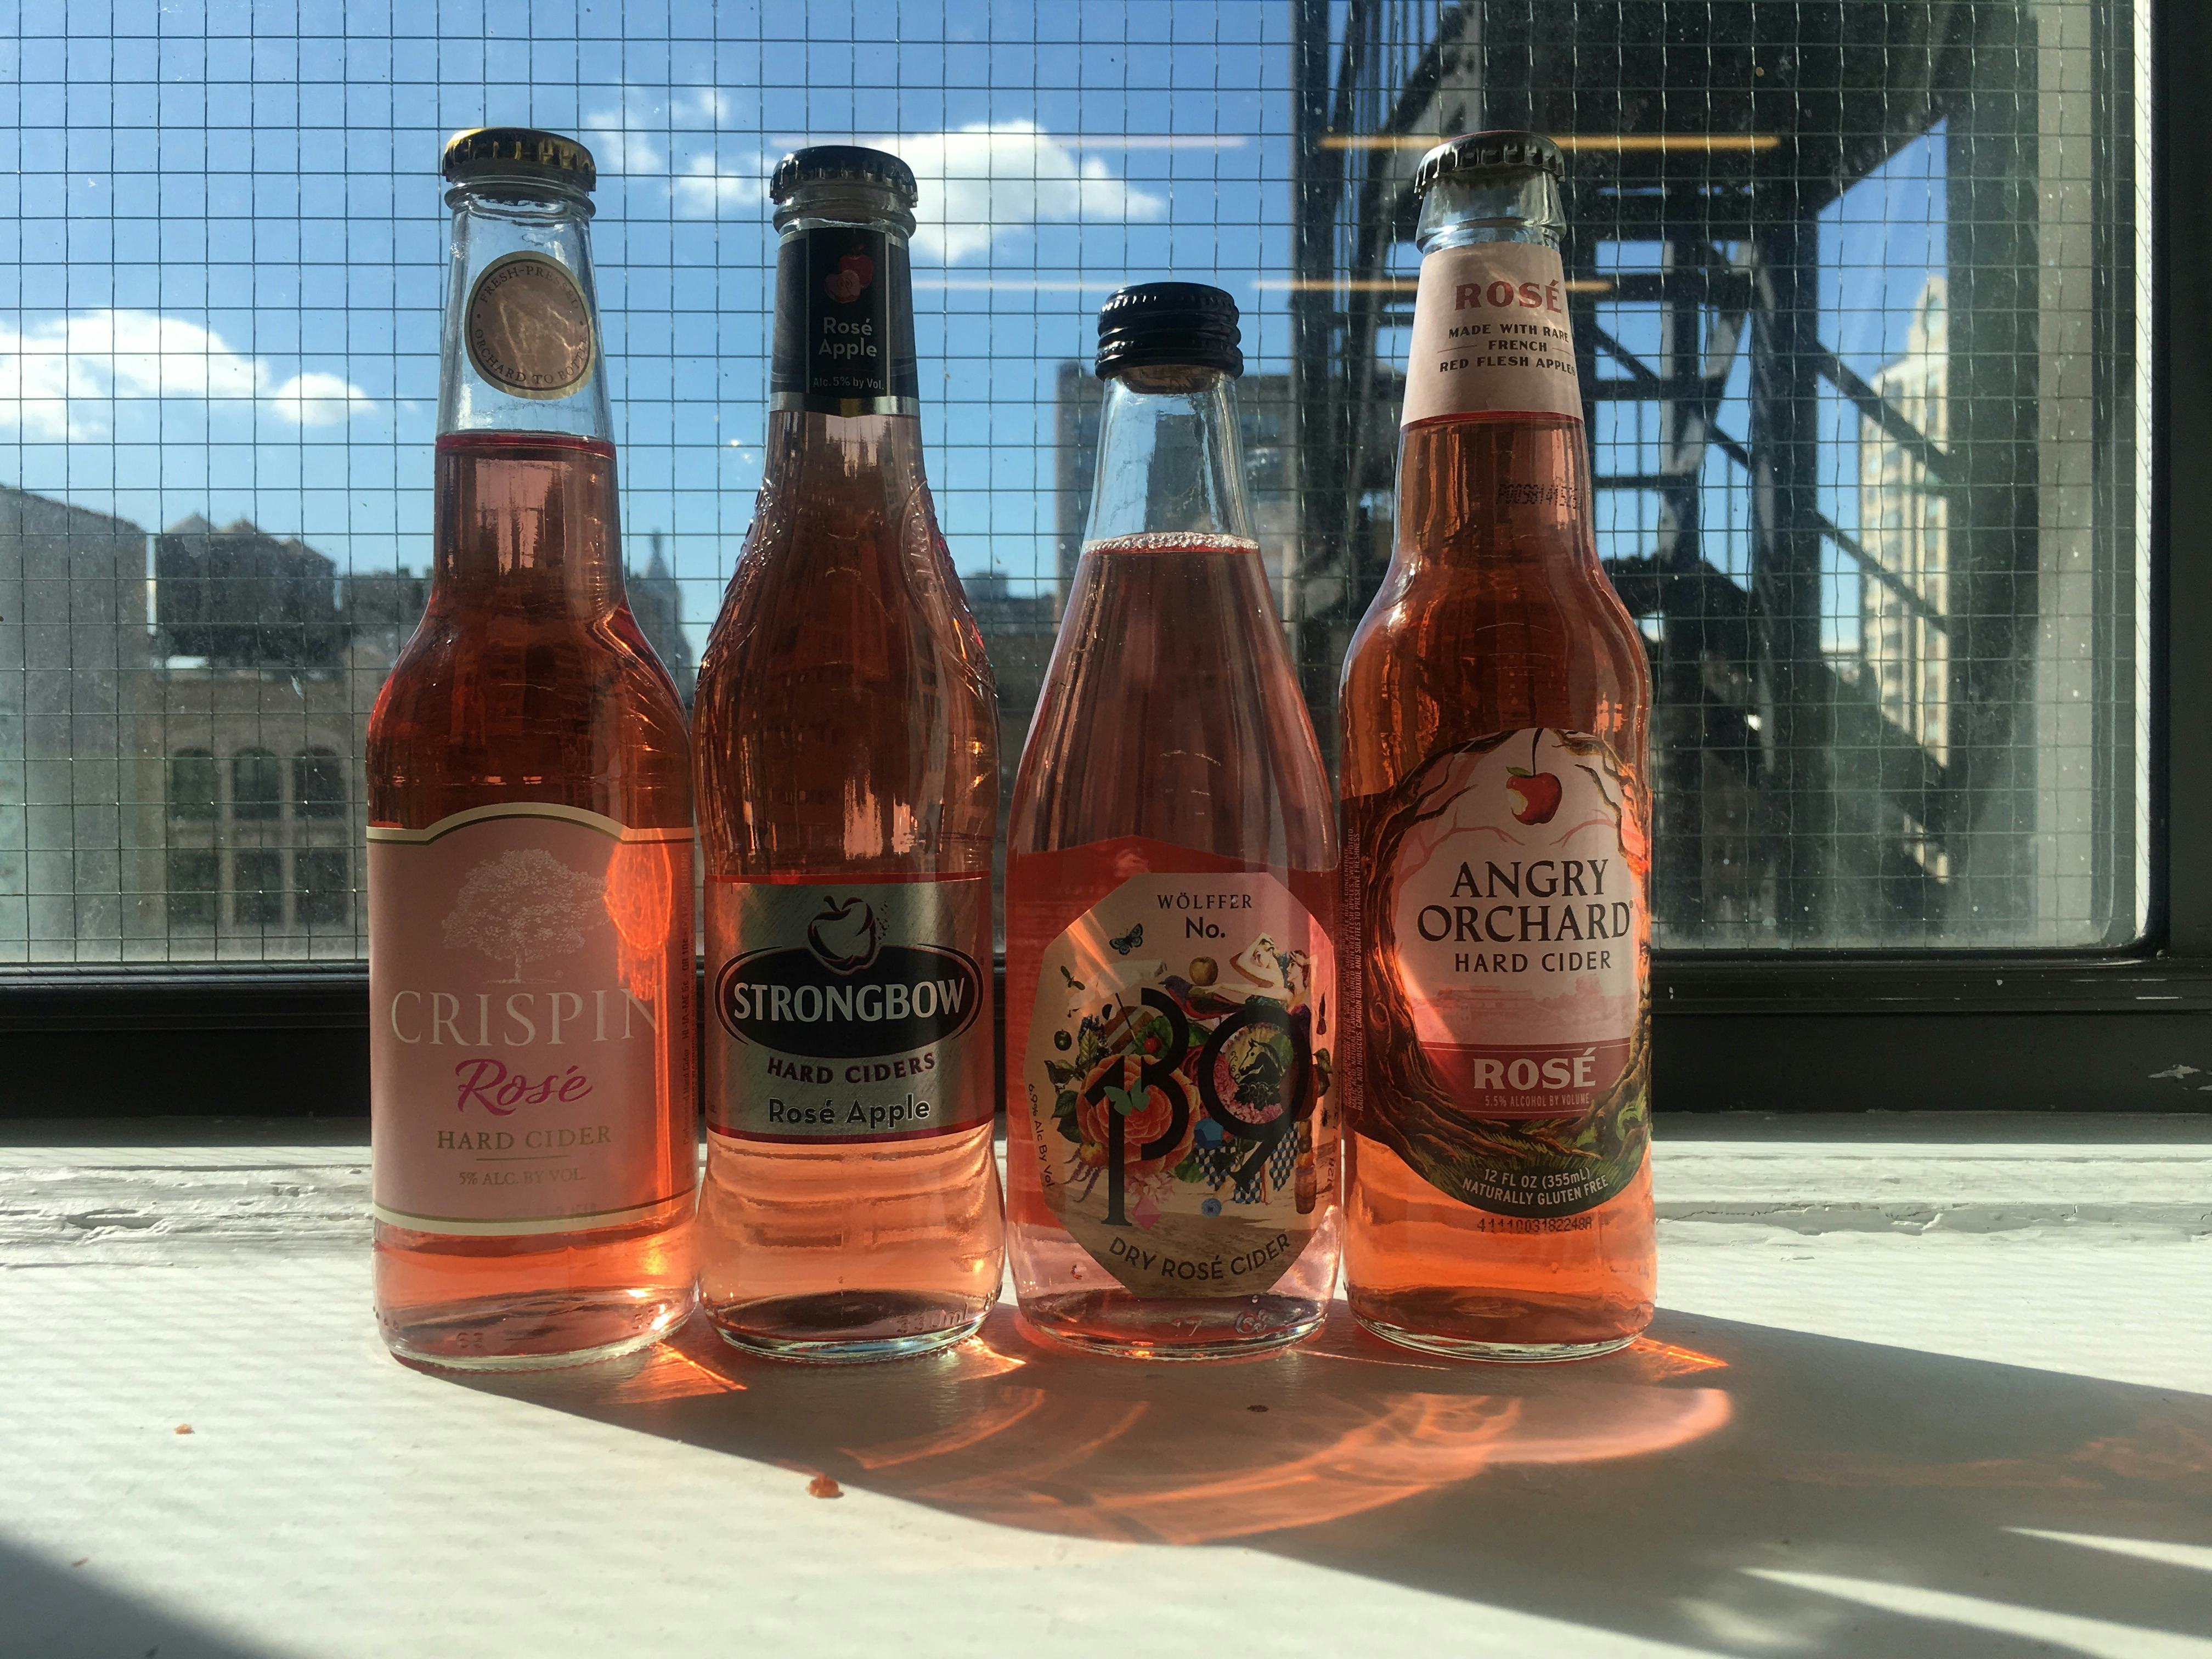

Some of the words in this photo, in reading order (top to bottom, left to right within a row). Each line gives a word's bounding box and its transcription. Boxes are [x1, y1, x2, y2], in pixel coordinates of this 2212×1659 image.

[1455, 279, 1561, 313] ROSÉ
[824, 317, 873, 336] Rosé
[1448, 324, 1491, 339] MADE
[1500, 323, 1537, 336] WITH
[1543, 326, 1569, 343] RARE
[475, 329, 527, 382] ORCHARD
[532, 374, 554, 385] TO
[558, 335, 587, 381] BOTTLE
[819, 338, 878, 360] Apple
[1488, 340, 1547, 352] FRENCH
[1440, 359, 1469, 373] RED
[1477, 356, 1529, 367] FLESH
[1536, 358, 1576, 376] APPLES
[812, 377, 831, 387] Alc.
[833, 376, 850, 387] 5%
[853, 377, 865, 389] by
[867, 378, 885, 391] Vol.
[1449, 859, 1609, 898] ANGRY
[1156, 893, 1252, 909] WÖLFFER
[1185, 917, 1226, 939] No.
[1417, 900, 1631, 943] ORCHARD
[1455, 953, 1528, 973] HARD
[1542, 950, 1612, 973] CIDER
[733, 977, 966, 1022] STRONGBOW
[391, 986, 661, 1047] CRISPIN
[767, 1057, 834, 1085] HARD
[844, 1052, 935, 1084] CIDERS
[1473, 1047, 1596, 1090] ROSÉ
[455, 1058, 593, 1116] Rosé
[769, 1098, 836, 1125] Rosé
[847, 1092, 930, 1129] Apple
[1028, 1083, 1039, 1117] 6.9%
[1485, 1094, 1508, 1108] 5.5%
[1510, 1094, 1548, 1108] ALCOHOL
[1549, 1094, 1560, 1107] BY
[1561, 1093, 1590, 1106] VOLUME
[437, 1130, 515, 1151] HARD
[524, 1125, 612, 1149] CIDER
[1034, 1120, 1044, 1142] Alc
[1039, 1144, 1048, 1162] By
[459, 1171, 478, 1186] 5%
[482, 1171, 520, 1186] ALC.
[523, 1171, 543, 1186] BY
[548, 1167, 587, 1185] VOL.
[1043, 1164, 1056, 1187] Vol
[1483, 1167, 1499, 1181] 12
[1501, 1172, 1516, 1187] FL
[1521, 1175, 1537, 1188] OZ
[1541, 1166, 1591, 1189] (355mL)
[1462, 1178, 1534, 1206] NATURALLY
[1537, 1188, 1582, 1206] GLUTEN
[1583, 1174, 1609, 1199] FREE
[1108, 1236, 1158, 1271] DRY
[1161, 1255, 1224, 1280] ROSÉ
[1230, 1232, 1292, 1276] CIDER
